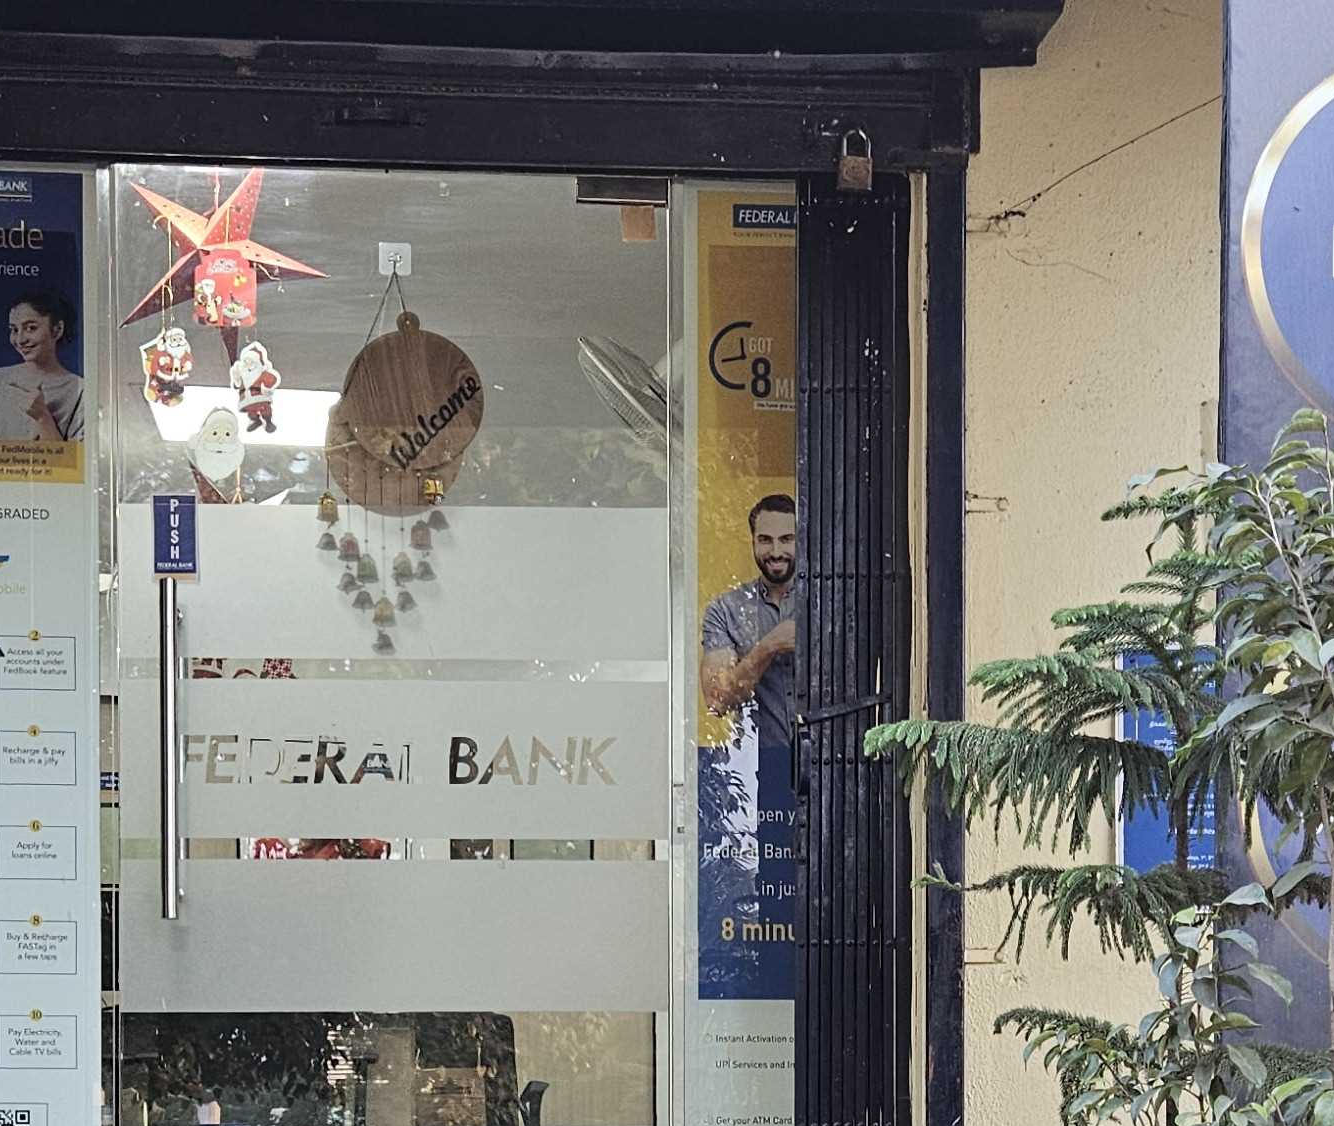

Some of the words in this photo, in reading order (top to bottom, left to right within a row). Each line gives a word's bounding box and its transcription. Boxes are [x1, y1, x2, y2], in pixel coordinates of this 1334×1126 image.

[0, 180, 28, 192] BANK
[738, 209, 791, 224] FEDERAL
[749, 336, 775, 353] GOT
[750, 356, 772, 399] 8
[390, 375, 481, 471] Welcome
[170, 498, 180, 559] PUSH
[6, 657, 41, 665] accounts
[3, 746, 40, 756] Recharge
[185, 734, 417, 785] FEDERAL
[449, 735, 619, 786] BANK
[16, 841, 40, 850] Apply
[41, 841, 52, 849] for
[12, 851, 32, 859] loans
[34, 851, 57, 859] online
[703, 842, 759, 860] Federal
[764, 844, 796, 859] Ban
[761, 881, 775, 896] in
[721, 917, 735, 942] 8
[742, 918, 796, 942] minu
[6, 932, 21, 941] Buy
[31, 932, 68, 942] Recharge
[31, 1009, 43, 1020] 10
[8, 1028, 22, 1037] Pay
[14, 1038, 39, 1046] Water
[715, 1034, 745, 1043] Instant
[746, 1034, 787, 1043] Activation
[9, 1047, 32, 1056] Cable
[732, 1060, 767, 1069] Services
[768, 1060, 786, 1069] and
[715, 1116, 731, 1125] Get
[732, 1118, 751, 1126] your
[752, 1116, 771, 1125] ATM
[772, 1116, 793, 1125] Card
